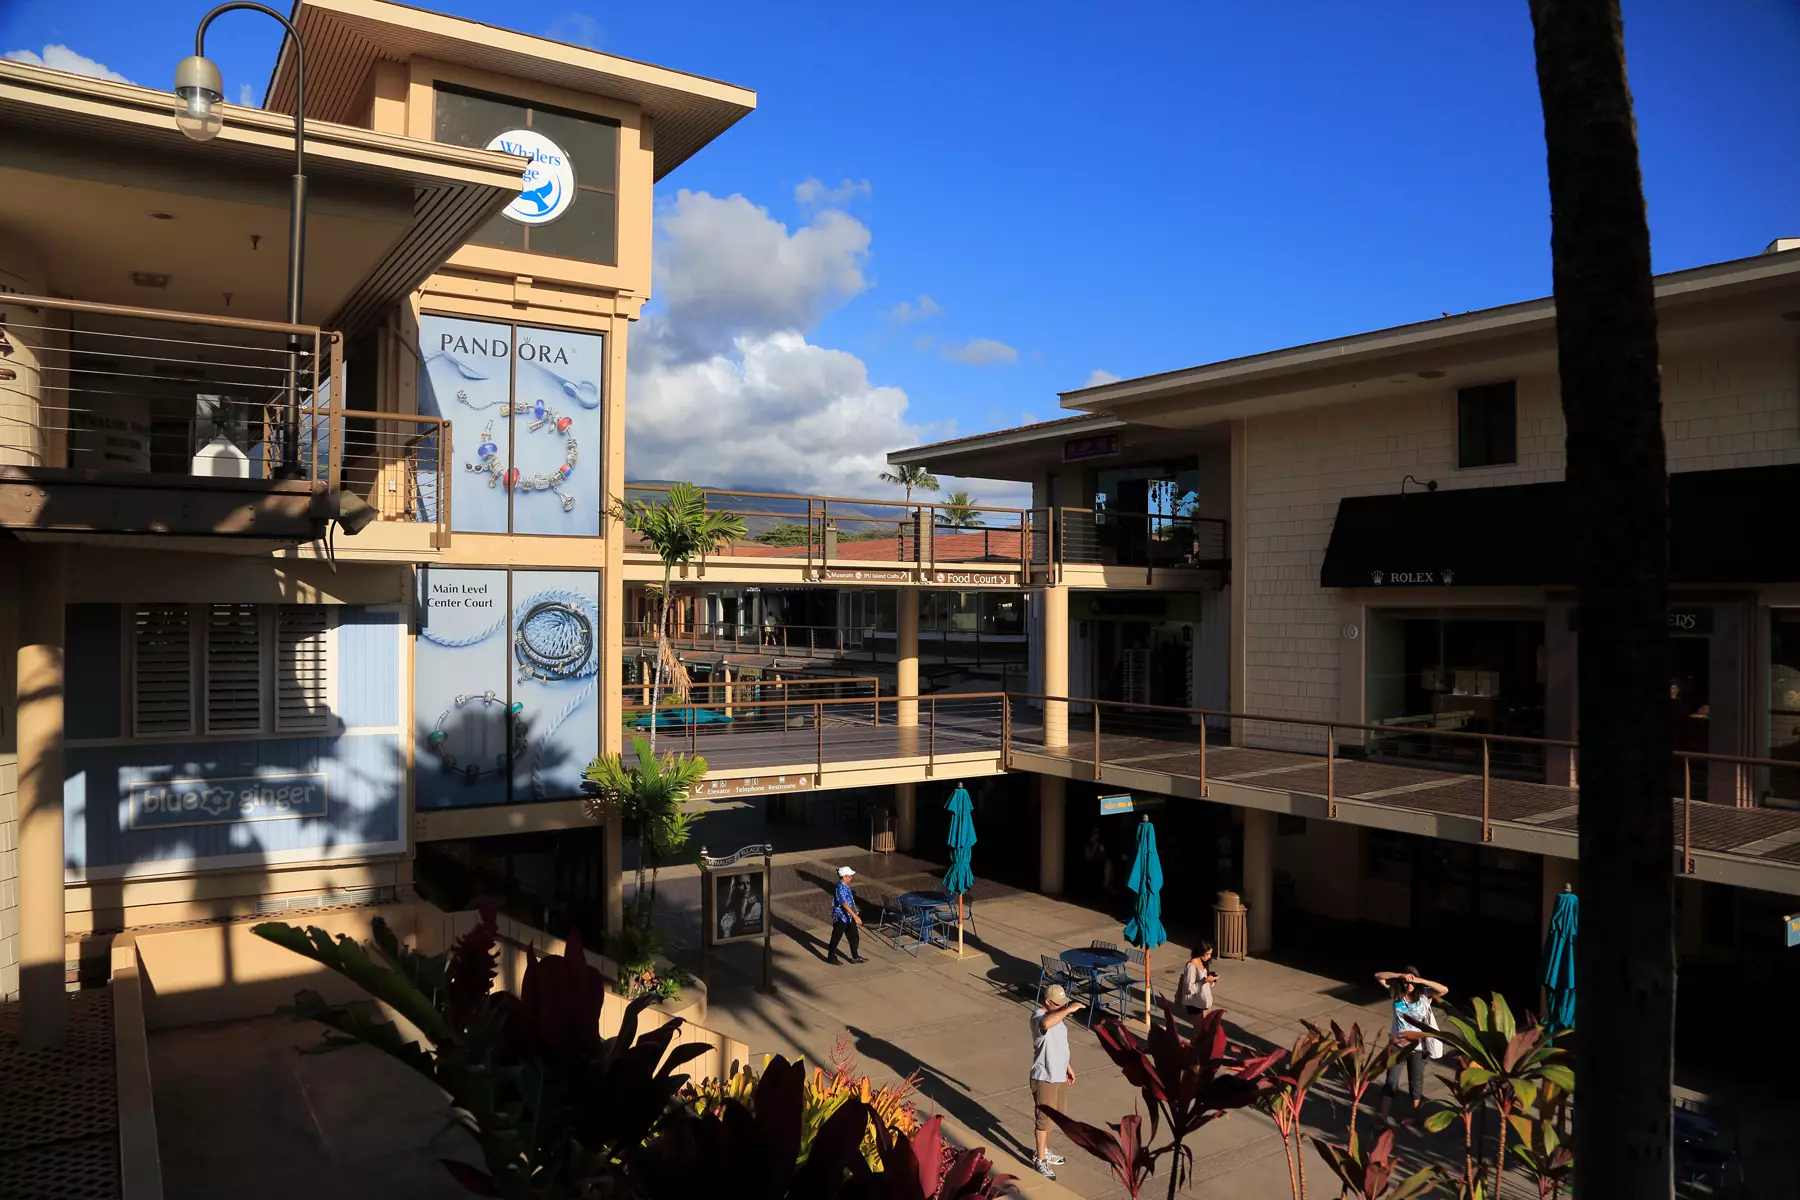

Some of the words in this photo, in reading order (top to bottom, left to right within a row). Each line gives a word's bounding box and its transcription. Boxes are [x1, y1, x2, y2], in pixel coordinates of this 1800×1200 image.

[500, 140, 561, 166] Whalers
[947, 573, 970, 583] Food
[973, 573, 997, 583] Court
[1390, 572, 1433, 583] ROLEX
[432, 584, 459, 594] Main
[462, 584, 487, 594] Level
[427, 598, 461, 607] Center
[464, 598, 493, 607] Court
[735, 785, 765, 793] Telephone
[768, 783, 796, 791] Restrooms
[144, 789, 198, 813] blue
[239, 783, 316, 814] ginger
